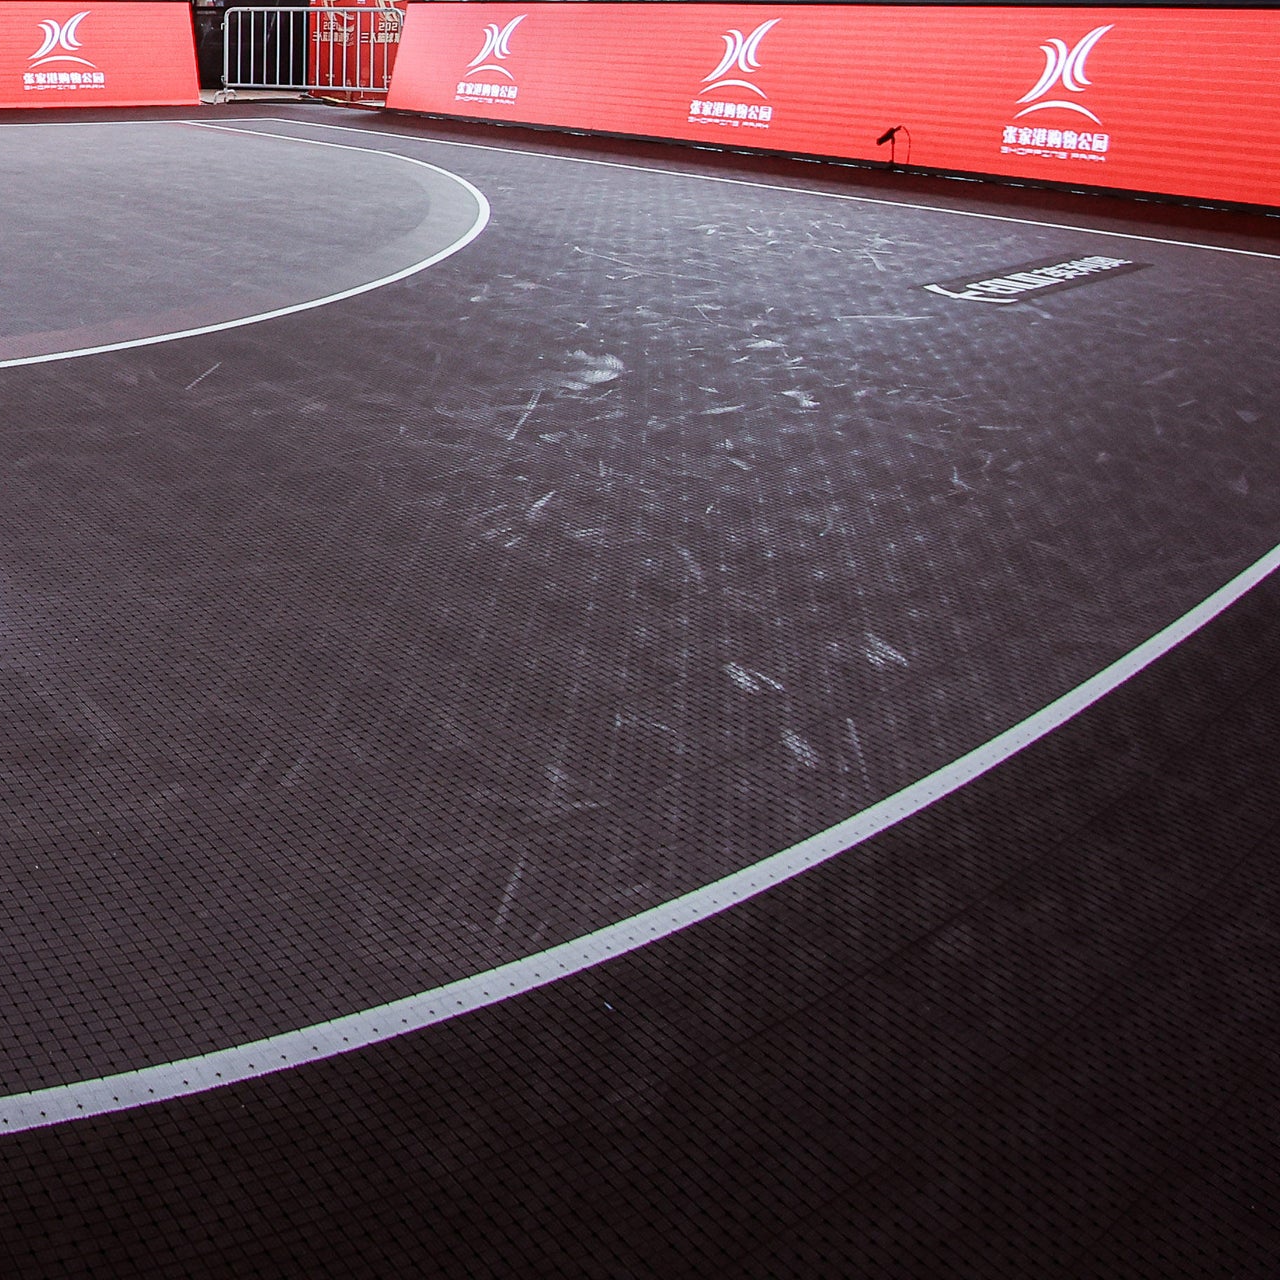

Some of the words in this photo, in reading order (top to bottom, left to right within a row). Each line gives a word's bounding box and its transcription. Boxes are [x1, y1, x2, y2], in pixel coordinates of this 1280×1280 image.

[1002, 125, 1109, 153] 张家港购物公园
